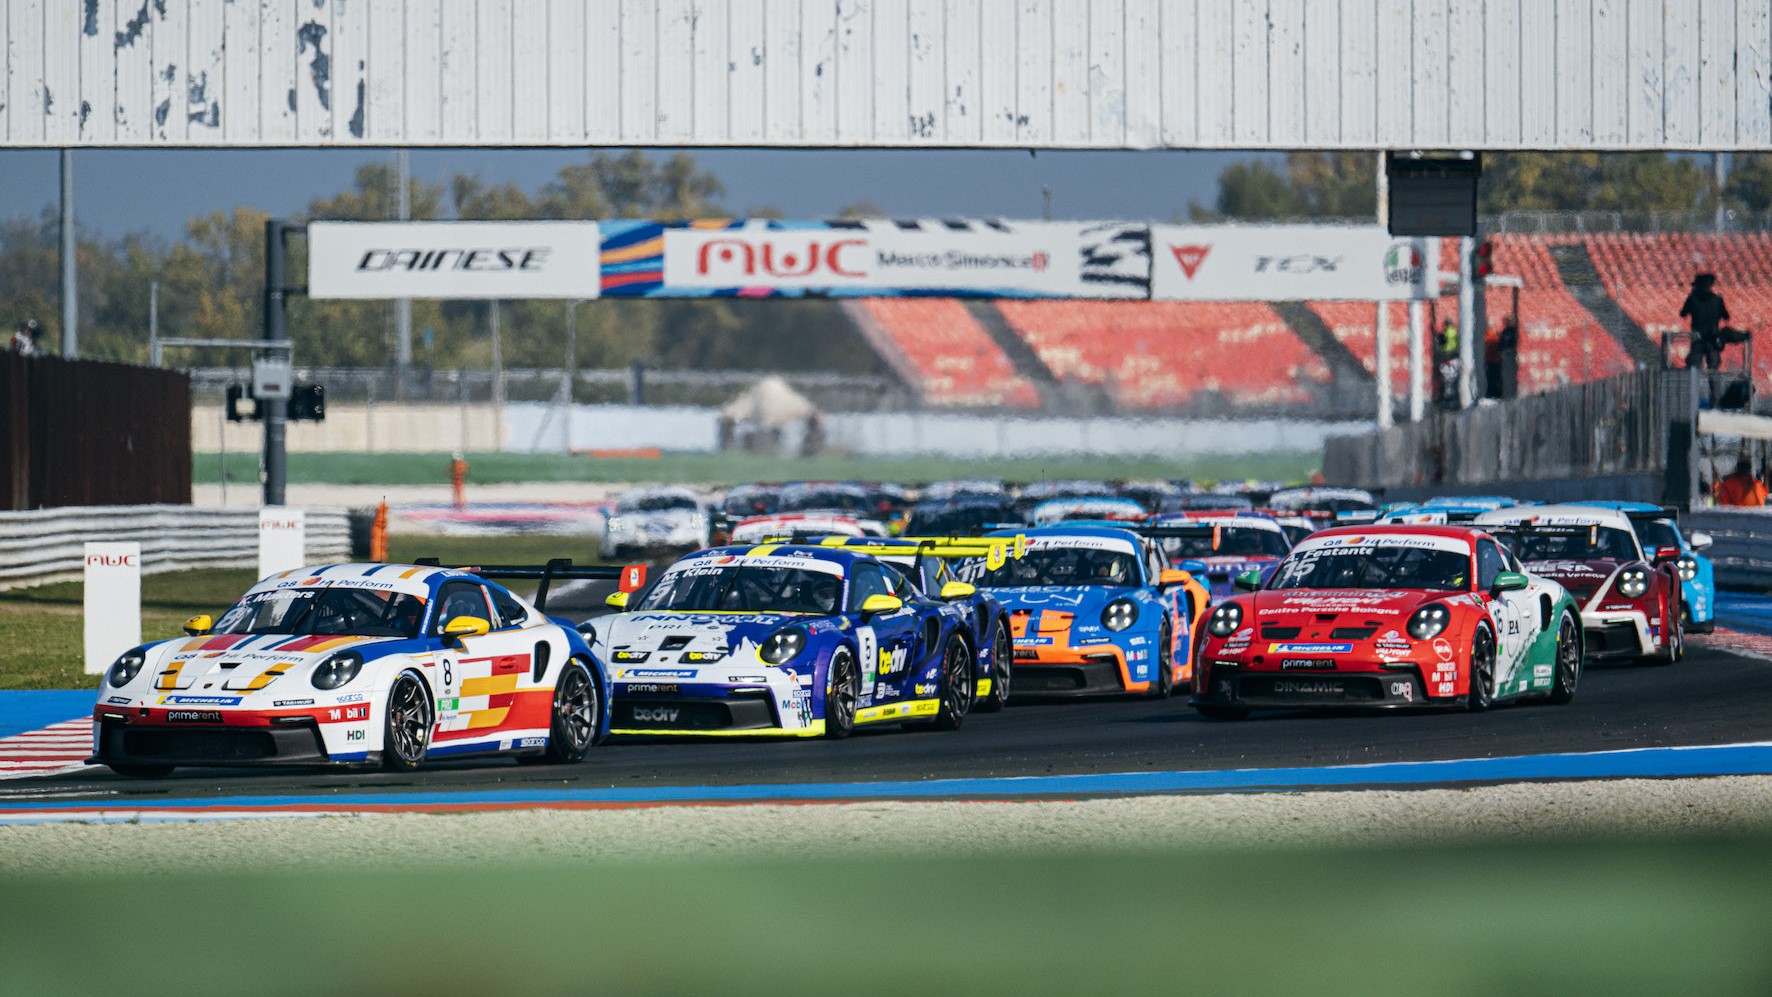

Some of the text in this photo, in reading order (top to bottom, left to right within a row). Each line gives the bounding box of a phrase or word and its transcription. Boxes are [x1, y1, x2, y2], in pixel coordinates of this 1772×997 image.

[356, 249, 550, 272] DAINESE
[697, 239, 868, 277] MWC
[1323, 539, 1343, 547] Q8
[1381, 538, 1436, 547] Perform
[1303, 547, 1374, 559] Festante
[87, 554, 138, 567] MWC
[693, 559, 713, 567] Q8
[752, 558, 806, 568] Perform
[1281, 557, 1320, 580] 15
[661, 566, 724, 583] M. Klein
[337, 579, 394, 589] Perform
[253, 590, 315, 603] Masters
[1259, 607, 1299, 615] Centro
[1351, 607, 1400, 615] Bologna
[865, 637, 871, 660] 5
[243, 653, 304, 662] Perform
[1282, 659, 1335, 670] primerent
[443, 658, 452, 686] 8
[627, 684, 679, 693] primerent
[1274, 682, 1345, 693] DINAMIC
[178, 696, 235, 705] MICHELIN
[168, 711, 221, 722] primerent
[347, 729, 366, 741] HDI
